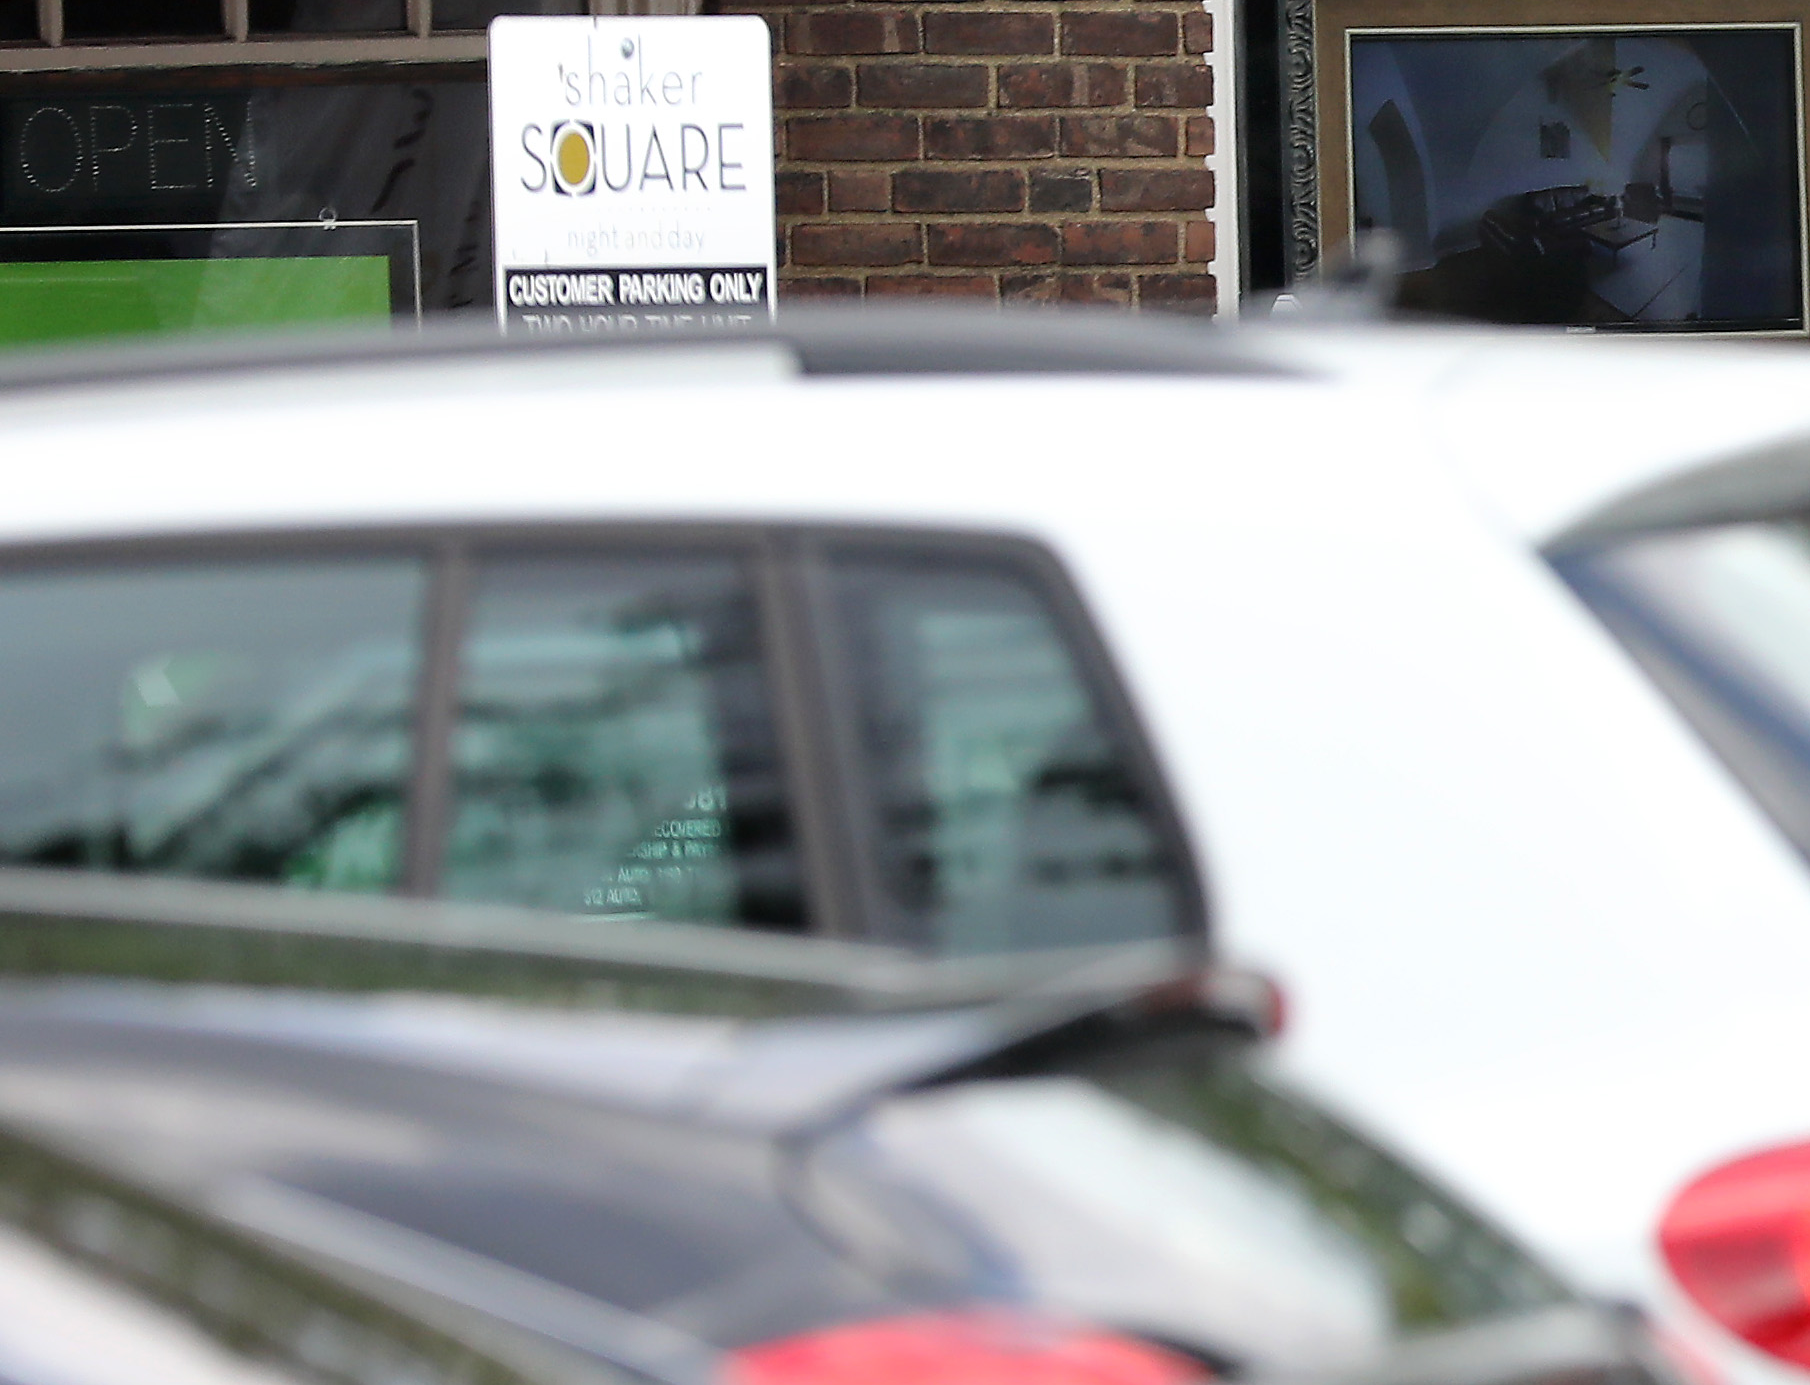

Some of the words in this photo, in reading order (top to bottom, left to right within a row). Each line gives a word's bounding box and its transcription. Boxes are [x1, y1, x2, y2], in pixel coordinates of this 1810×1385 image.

[563, 34, 702, 106] shaker
[20, 101, 257, 193] OPEN
[521, 119, 747, 197] SQUARE
[567, 223, 618, 257] night
[625, 220, 663, 250] and
[668, 219, 705, 252] day
[509, 273, 615, 306] CUSTOMER
[618, 272, 705, 305] PARKING
[710, 271, 763, 304] ONLY
